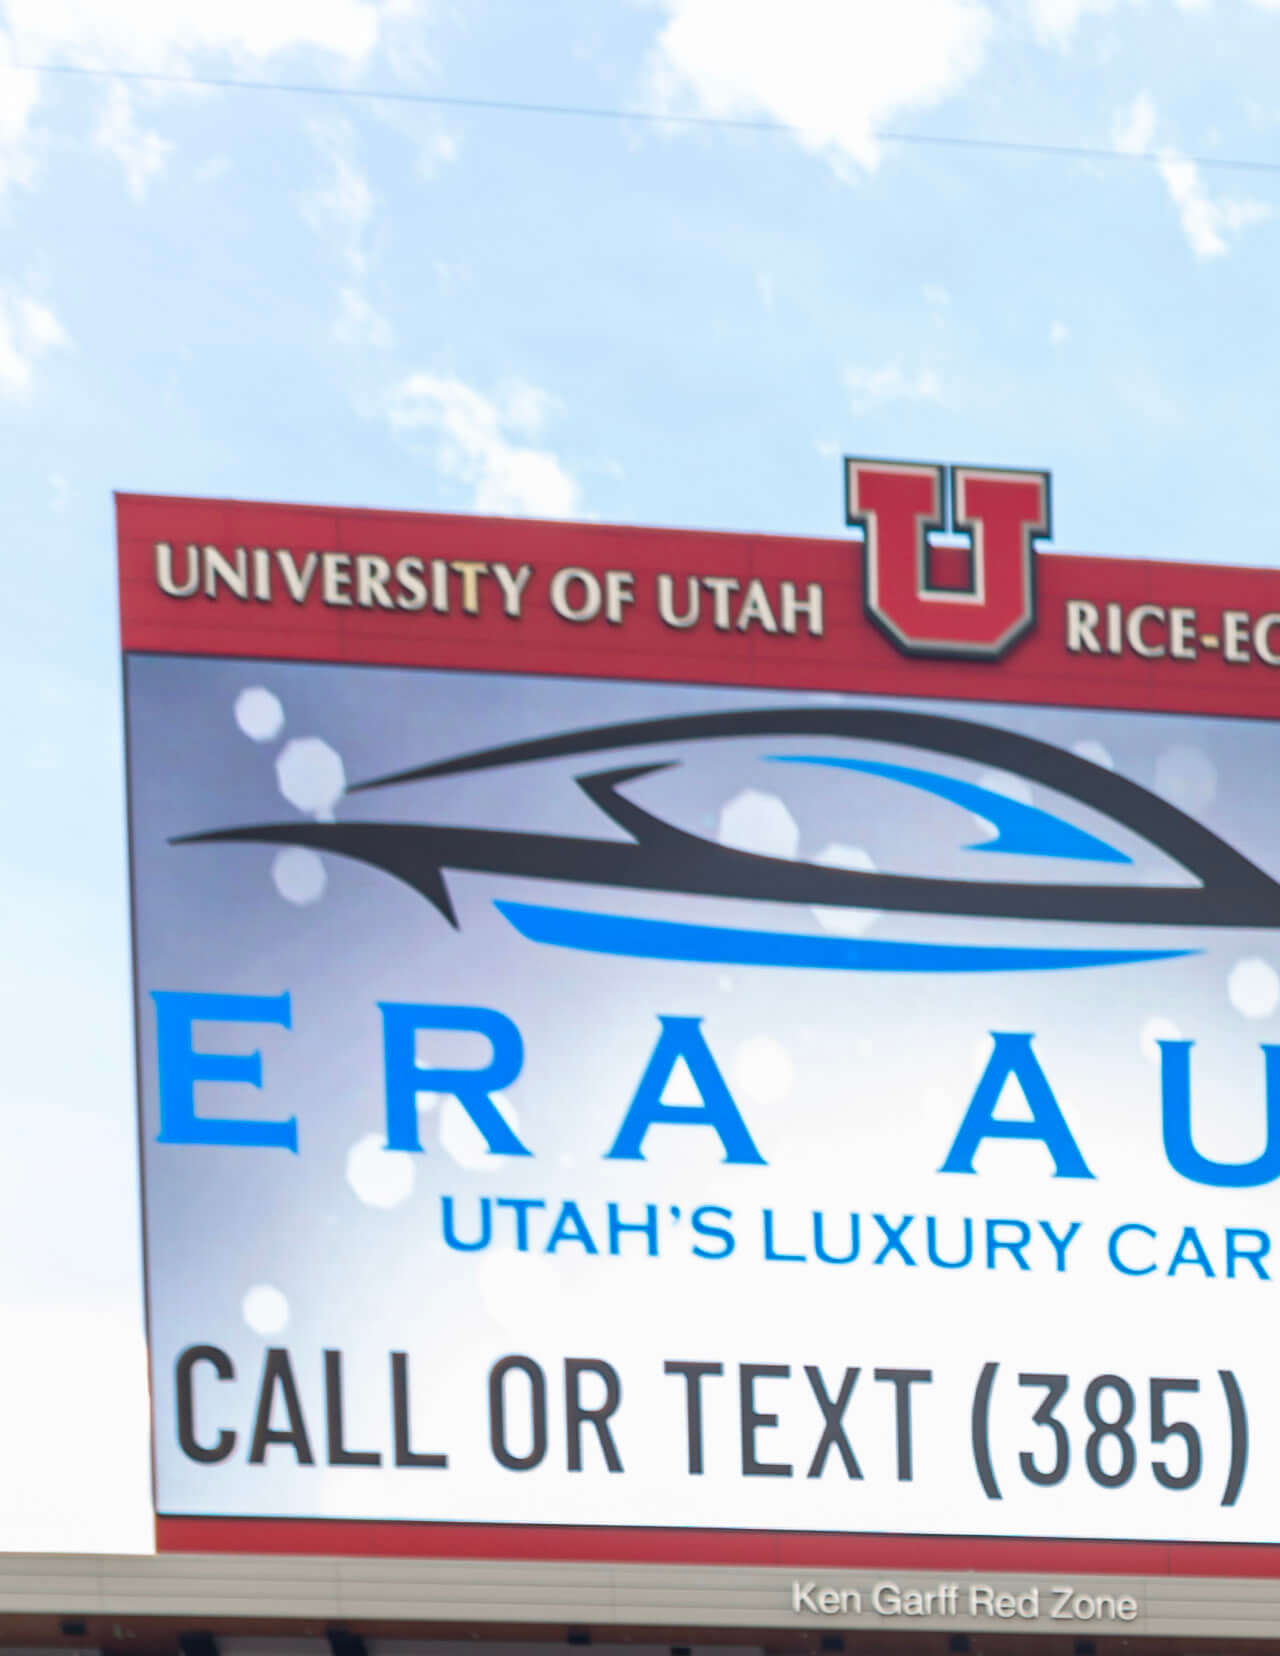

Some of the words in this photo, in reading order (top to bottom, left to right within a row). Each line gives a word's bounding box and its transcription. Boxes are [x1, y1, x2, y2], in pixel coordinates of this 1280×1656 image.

[153, 541, 531, 618] UNIVERSITY
[549, 566, 636, 625] OF
[657, 576, 826, 637] UTAH
[150, 990, 770, 1166] ERA
[439, 1194, 738, 1259] UTAH'S
[762, 1209, 1082, 1274] LUXURY
[1107, 1222, 1272, 1281] CAR
[174, 1344, 449, 1470] CALL
[487, 1354, 625, 1474] OR
[664, 1360, 933, 1483] TEXT
[971, 1361, 1249, 1507] (385)
[792, 1579, 862, 1616] Ken
[871, 1581, 959, 1617] Garff
[969, 1584, 1039, 1619] Red
[1049, 1586, 1138, 1622] Zone
